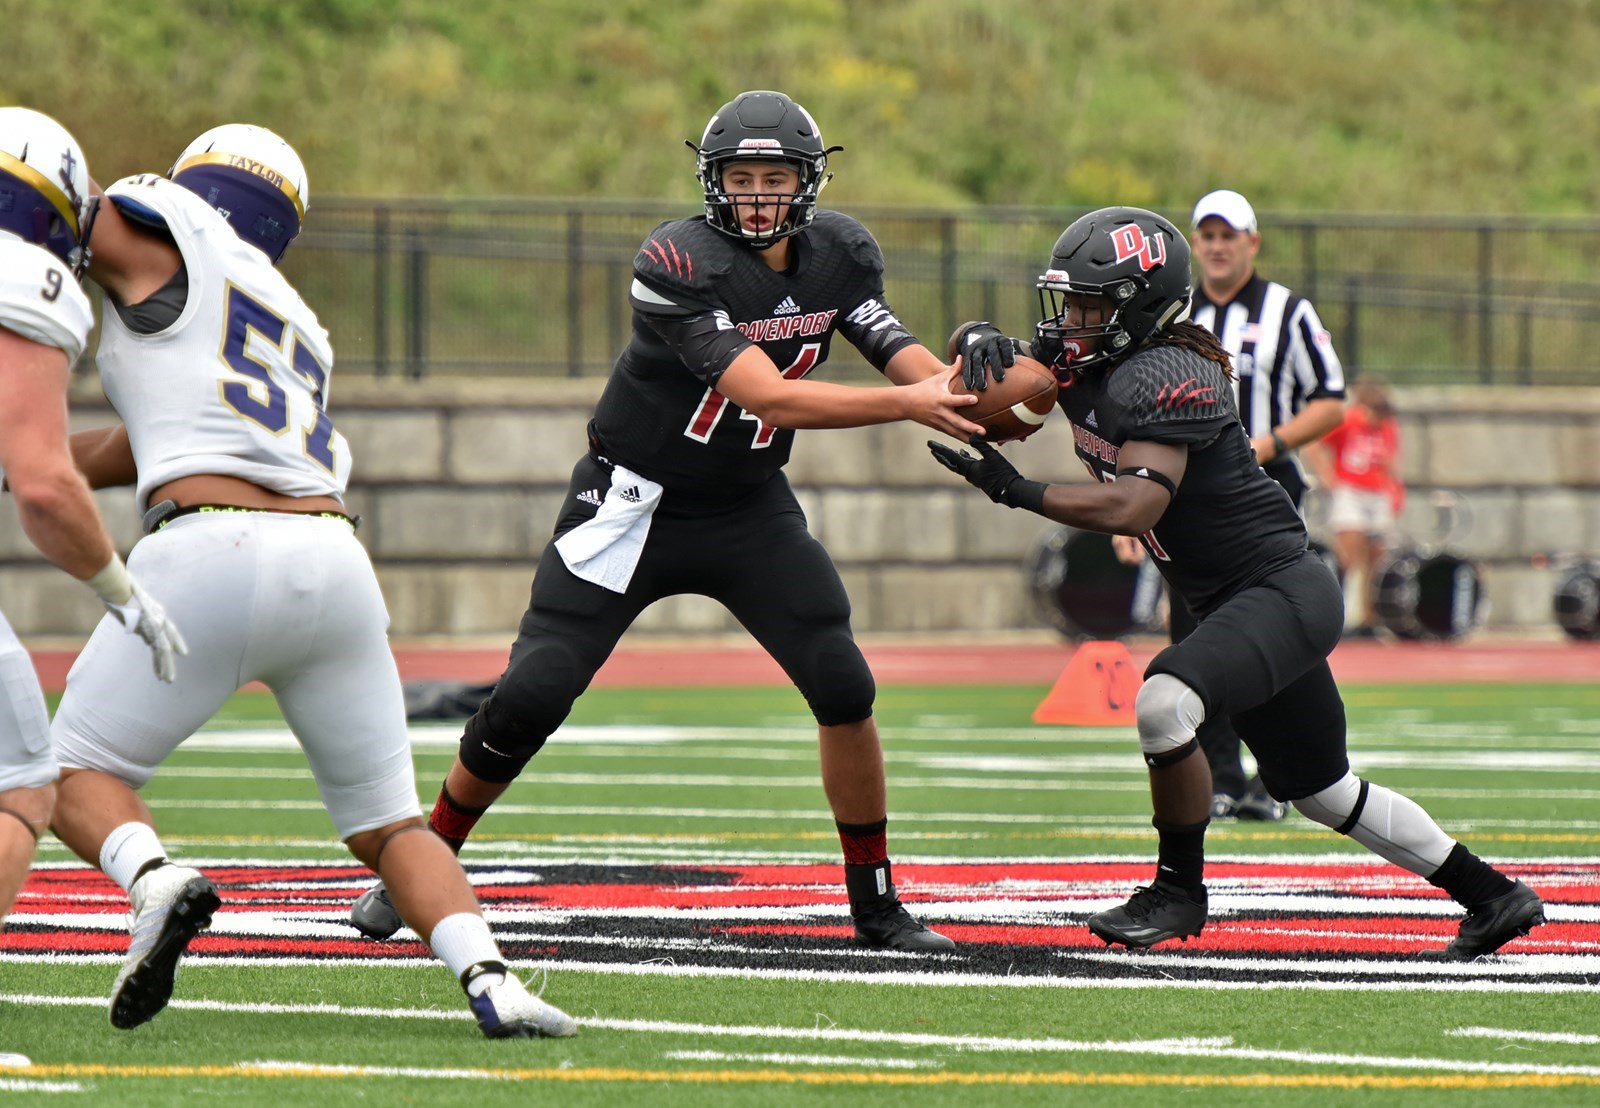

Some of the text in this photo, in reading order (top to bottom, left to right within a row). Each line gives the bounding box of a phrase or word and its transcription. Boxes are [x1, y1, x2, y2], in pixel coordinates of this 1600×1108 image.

[228, 154, 283, 188] TAYLOR
[1110, 223, 1166, 271] DU
[41, 268, 63, 302] 9
[736, 308, 838, 342] DAVENPORT
[773, 305, 801, 315] adidas
[216, 277, 336, 479] 57
[576, 494, 602, 506] adidas
